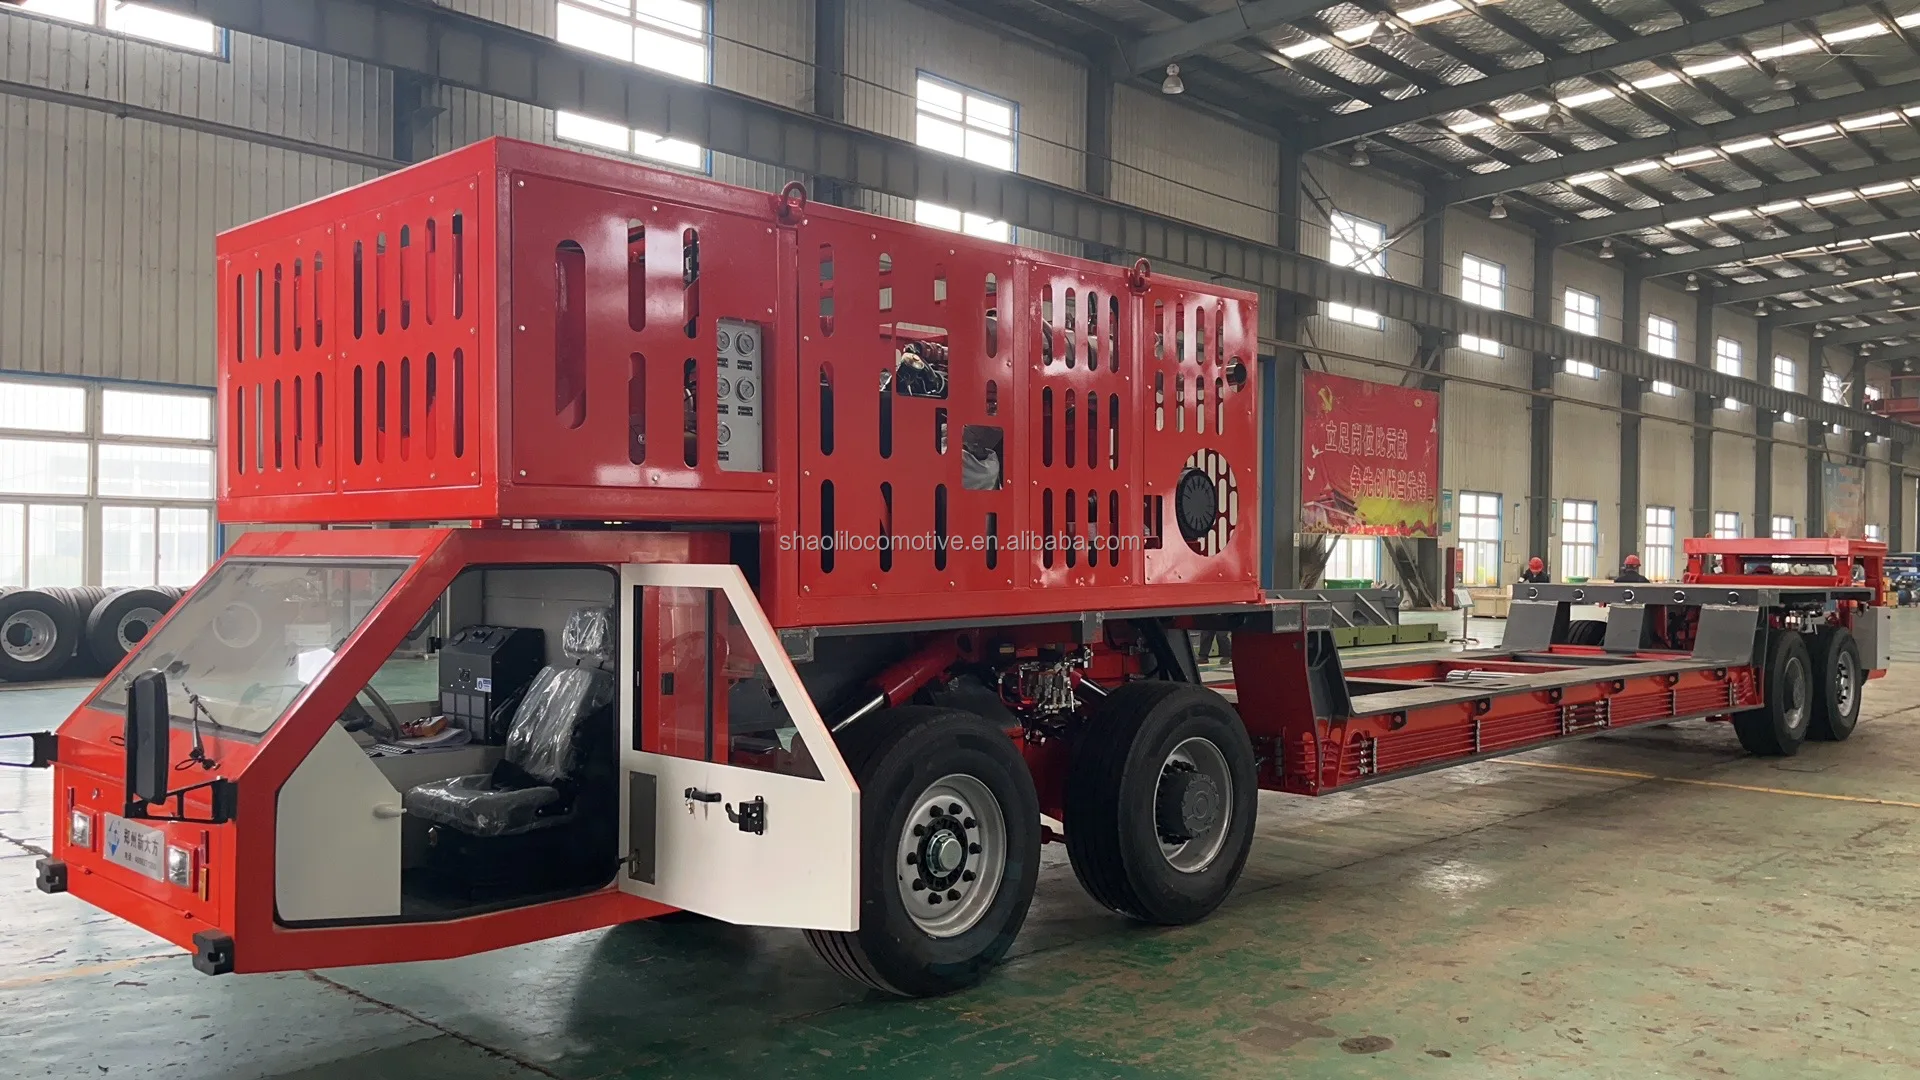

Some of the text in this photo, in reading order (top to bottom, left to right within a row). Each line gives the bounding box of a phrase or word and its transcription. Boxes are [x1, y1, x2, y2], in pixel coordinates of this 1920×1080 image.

[1324, 420, 1408, 460] 立足岗位比贡献
[1350, 465, 1427, 502] 争先创优当先锋
[123, 828, 159, 857] 郑州新大方
